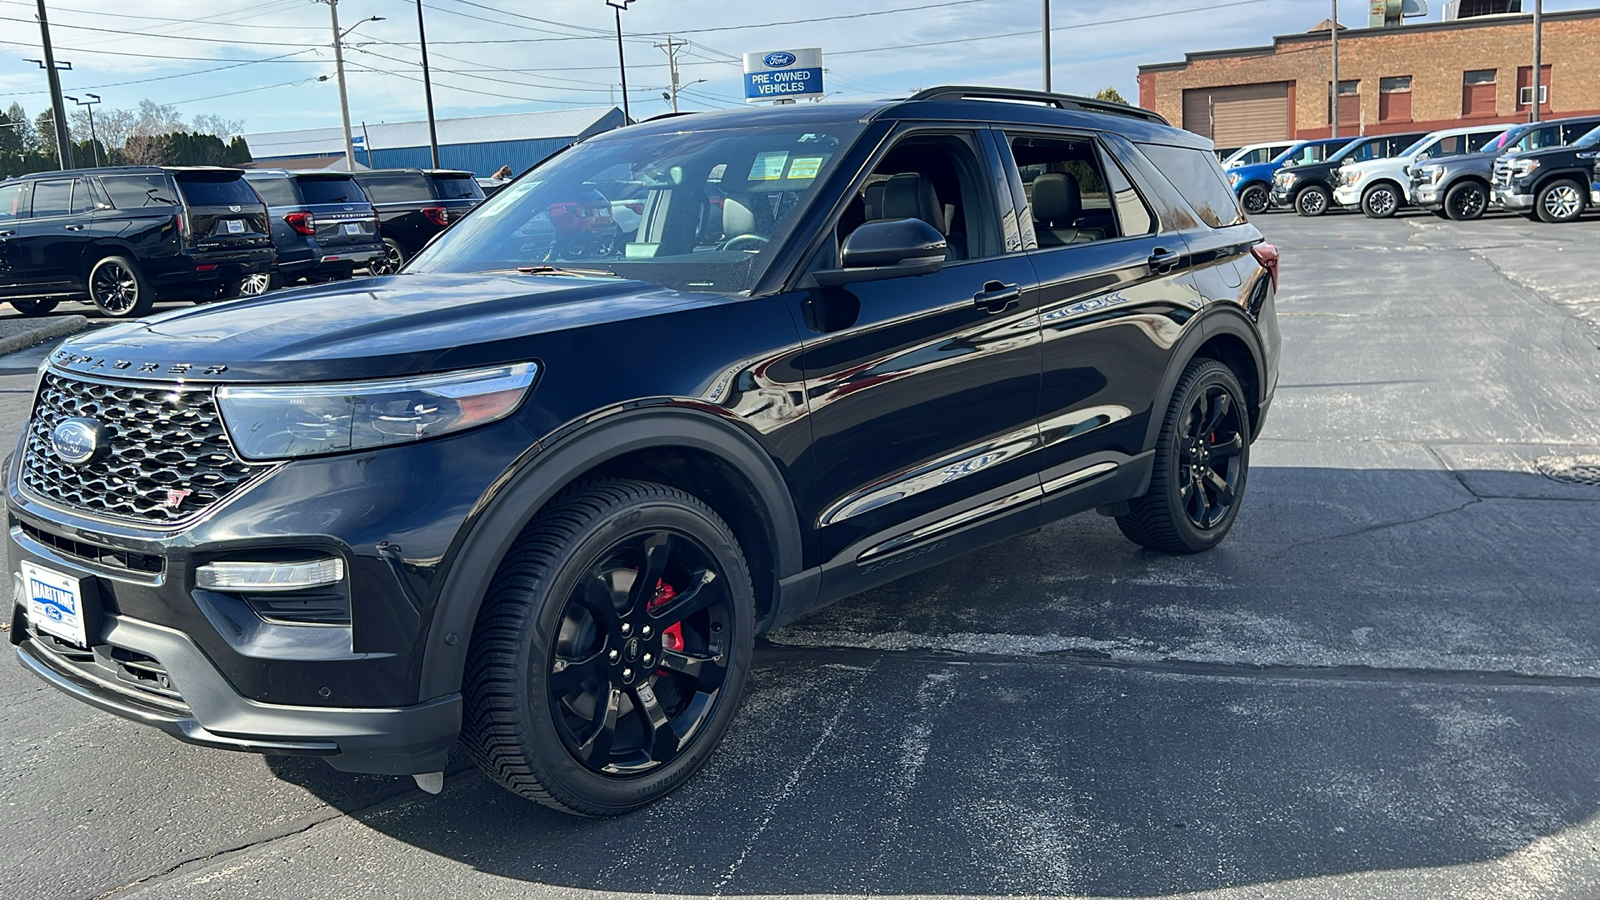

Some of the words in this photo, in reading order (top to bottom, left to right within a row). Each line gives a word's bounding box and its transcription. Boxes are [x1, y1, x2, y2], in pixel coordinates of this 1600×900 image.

[769, 55, 788, 65] Ford
[752, 71, 811, 84] PRE-OWNED
[758, 82, 805, 94] VEHICLES
[31, 580, 75, 614] MARITIME
